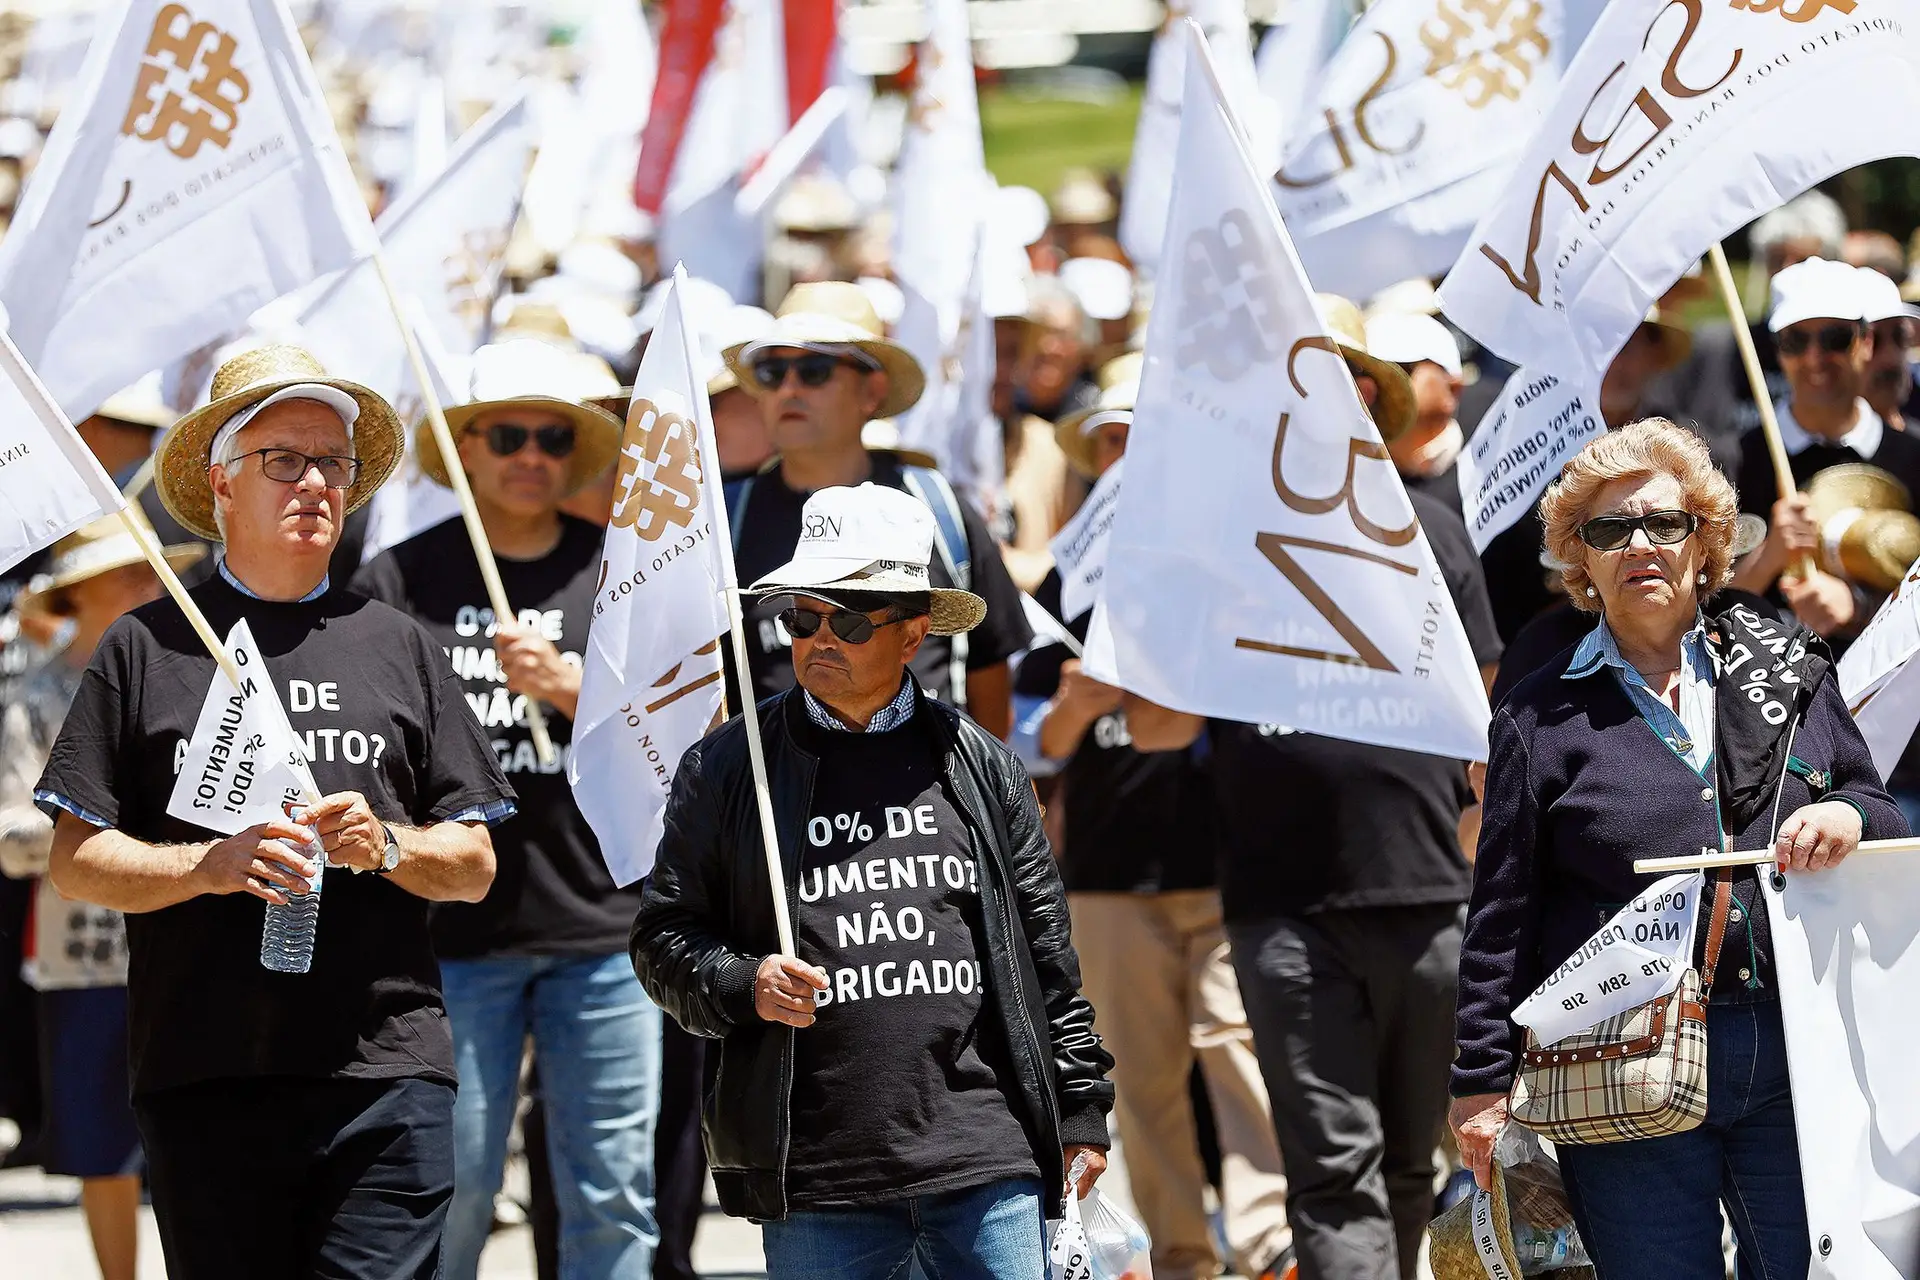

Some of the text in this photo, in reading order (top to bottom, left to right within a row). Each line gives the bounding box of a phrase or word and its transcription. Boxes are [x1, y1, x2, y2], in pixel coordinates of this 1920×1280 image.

[1568, 415, 1596, 440] 0%
[804, 514, 842, 538] SBN
[517, 608, 564, 641] DE
[288, 678, 341, 713] DE
[808, 804, 939, 847] 0% DE
[800, 854, 977, 903] UMENTO?
[836, 901, 936, 948] NÃO,
[814, 959, 984, 1008] BRIGADO!
[1481, 1235, 1494, 1254] SIB
